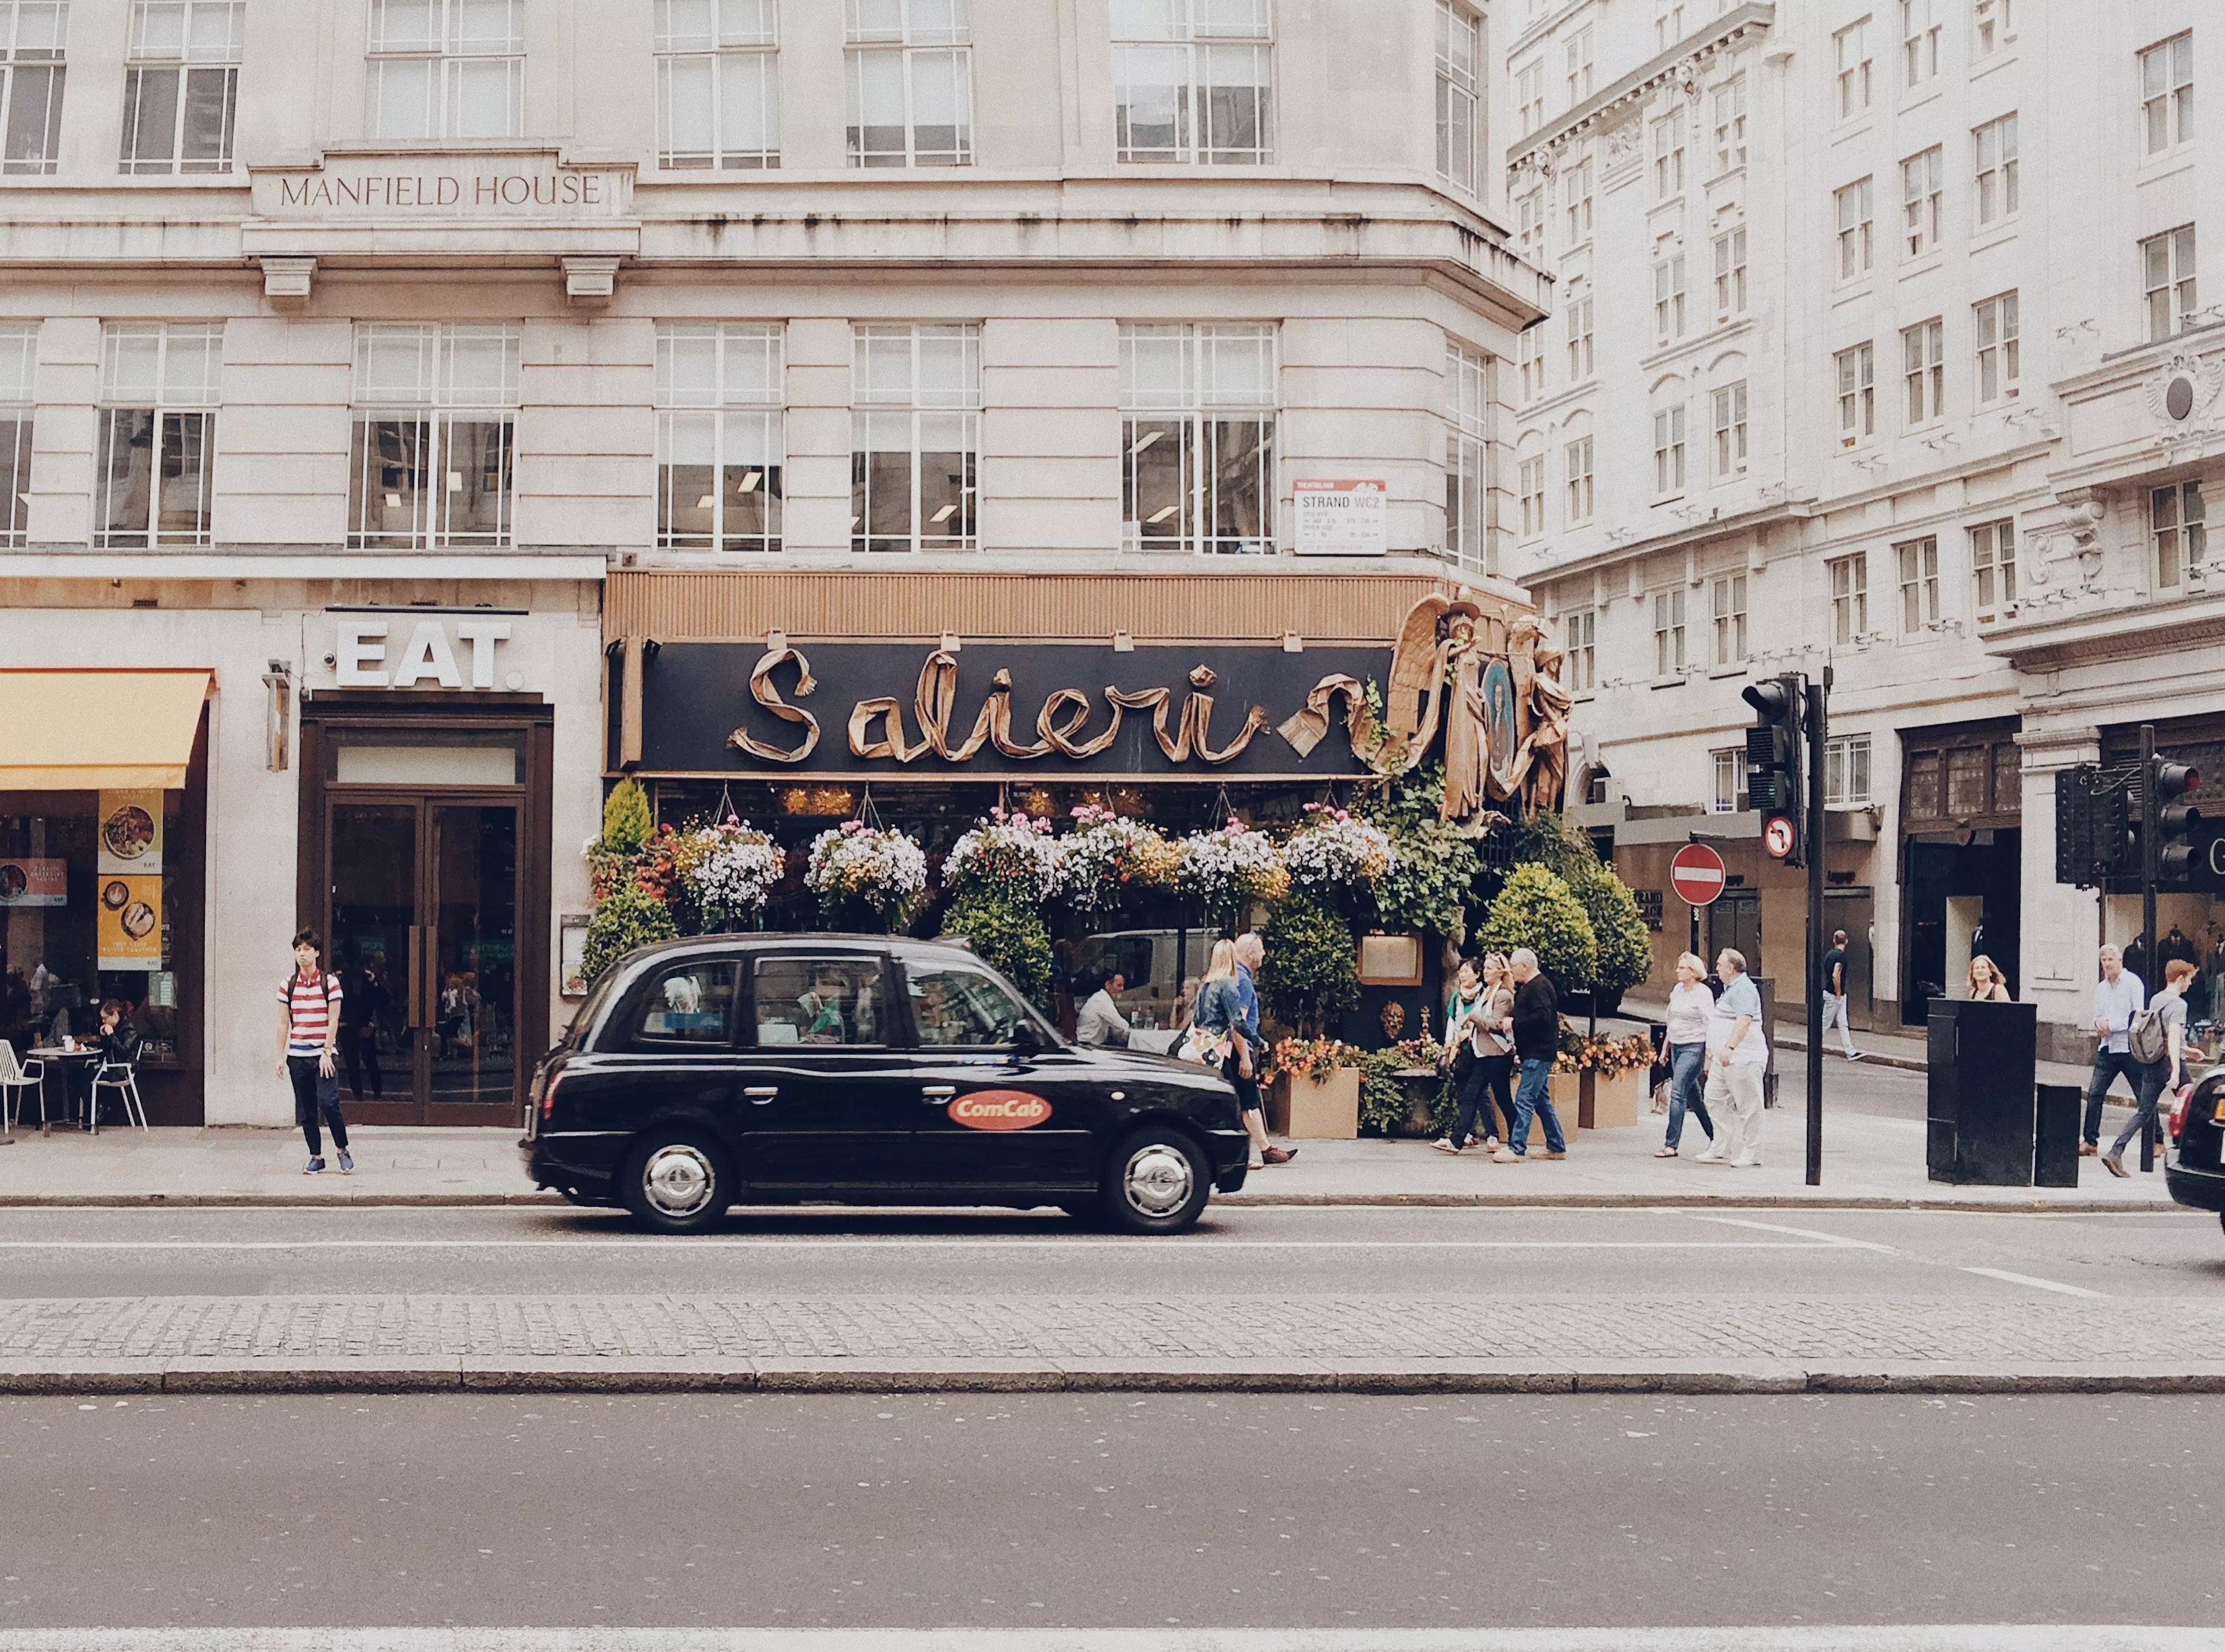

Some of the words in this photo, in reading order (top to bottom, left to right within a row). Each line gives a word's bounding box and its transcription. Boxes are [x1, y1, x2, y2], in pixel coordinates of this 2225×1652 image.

[281, 176, 459, 206] MANFIELD
[475, 176, 601, 205] HOUSE
[1302, 496, 1350, 508] STRAND
[1354, 497, 1380, 508] WC2
[726, 647, 1271, 764] Salieri
[956, 1099, 1044, 1117] ComCab
